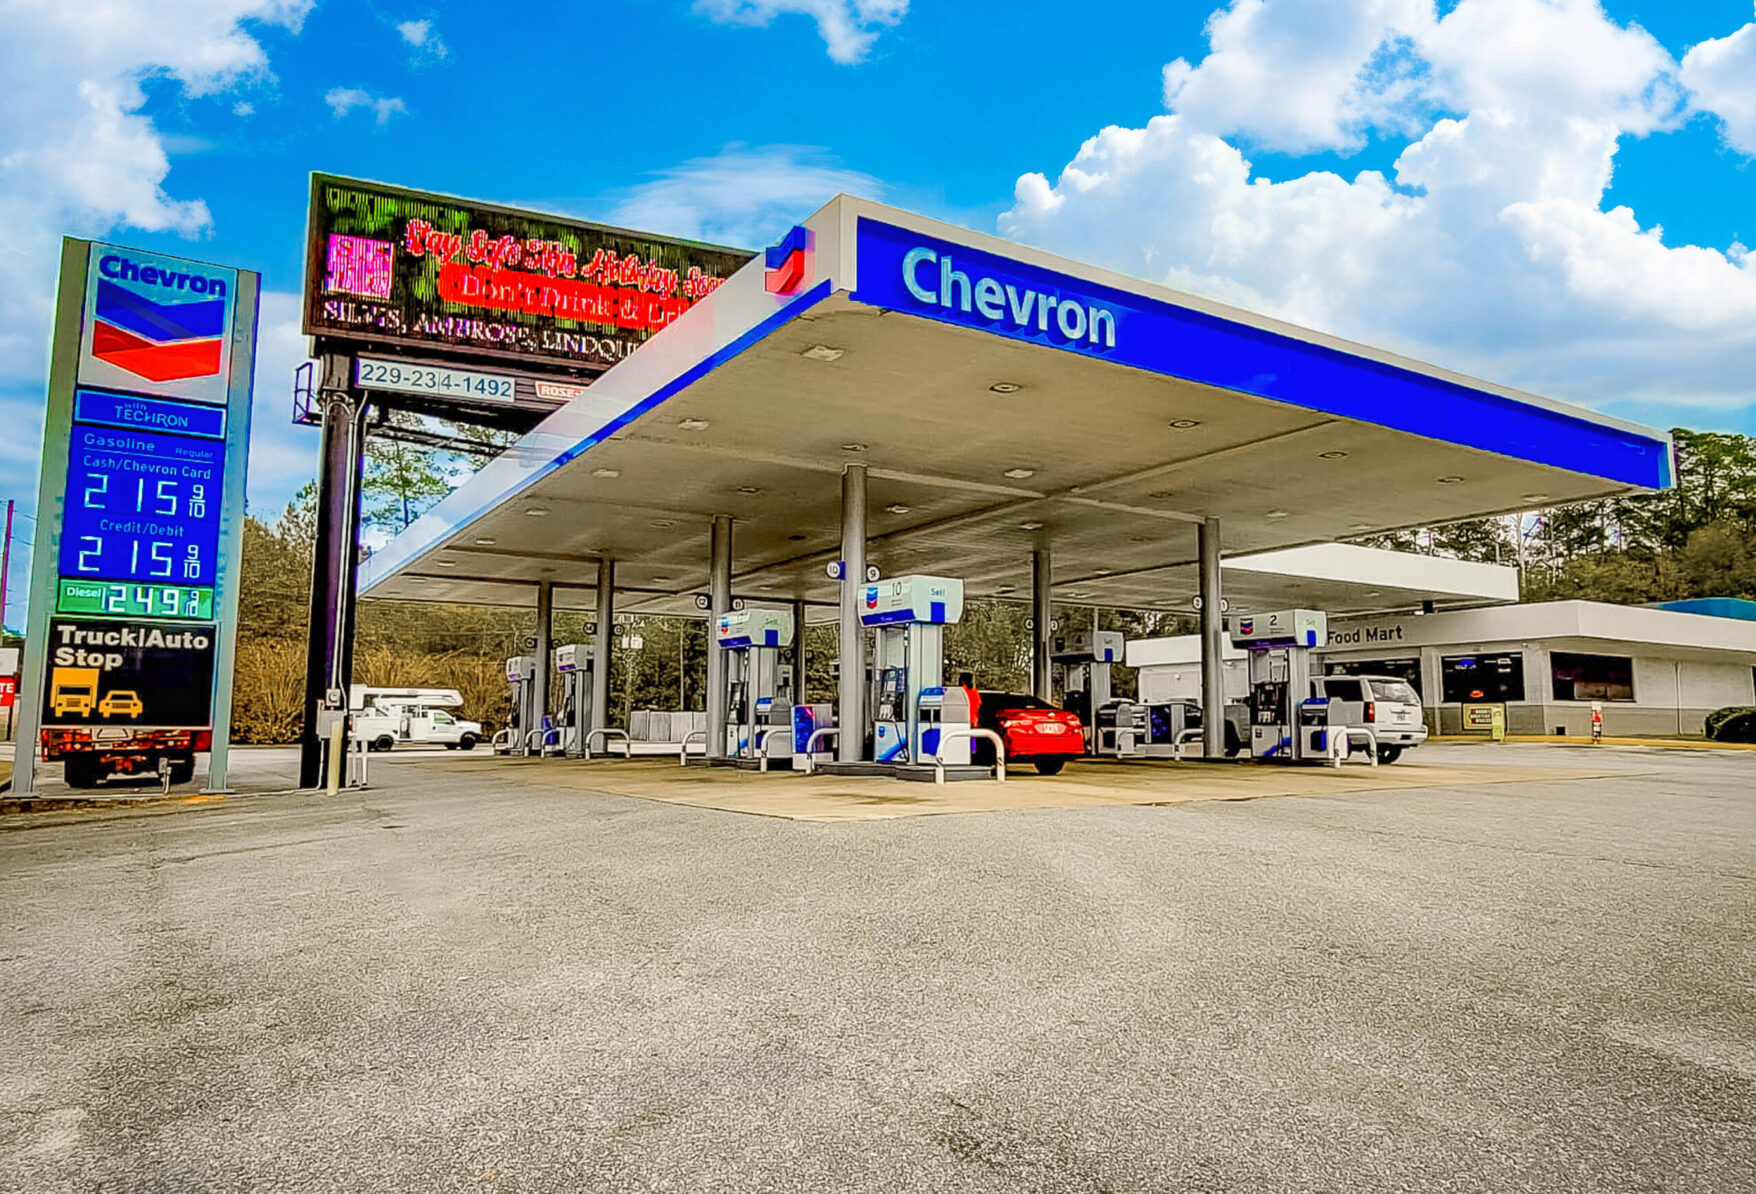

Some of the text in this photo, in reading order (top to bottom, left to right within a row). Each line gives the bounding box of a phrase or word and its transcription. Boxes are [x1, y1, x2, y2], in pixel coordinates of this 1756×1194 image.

[99, 255, 226, 297] Chevron
[902, 247, 1116, 347] Chevron
[361, 363, 512, 397] 229-234-1492
[114, 405, 189, 428] TECHRON
[124, 403, 147, 411] with
[83, 432, 156, 452] Gasoline
[175, 447, 214, 459] Regular
[181, 465, 212, 480] Card
[99, 518, 185, 538] Credit/Debit
[66, 586, 102, 598] Diesel
[1269, 615, 1278, 626] 2
[1327, 625, 1403, 645] Food Mart
[54, 647, 123, 671] Stop
